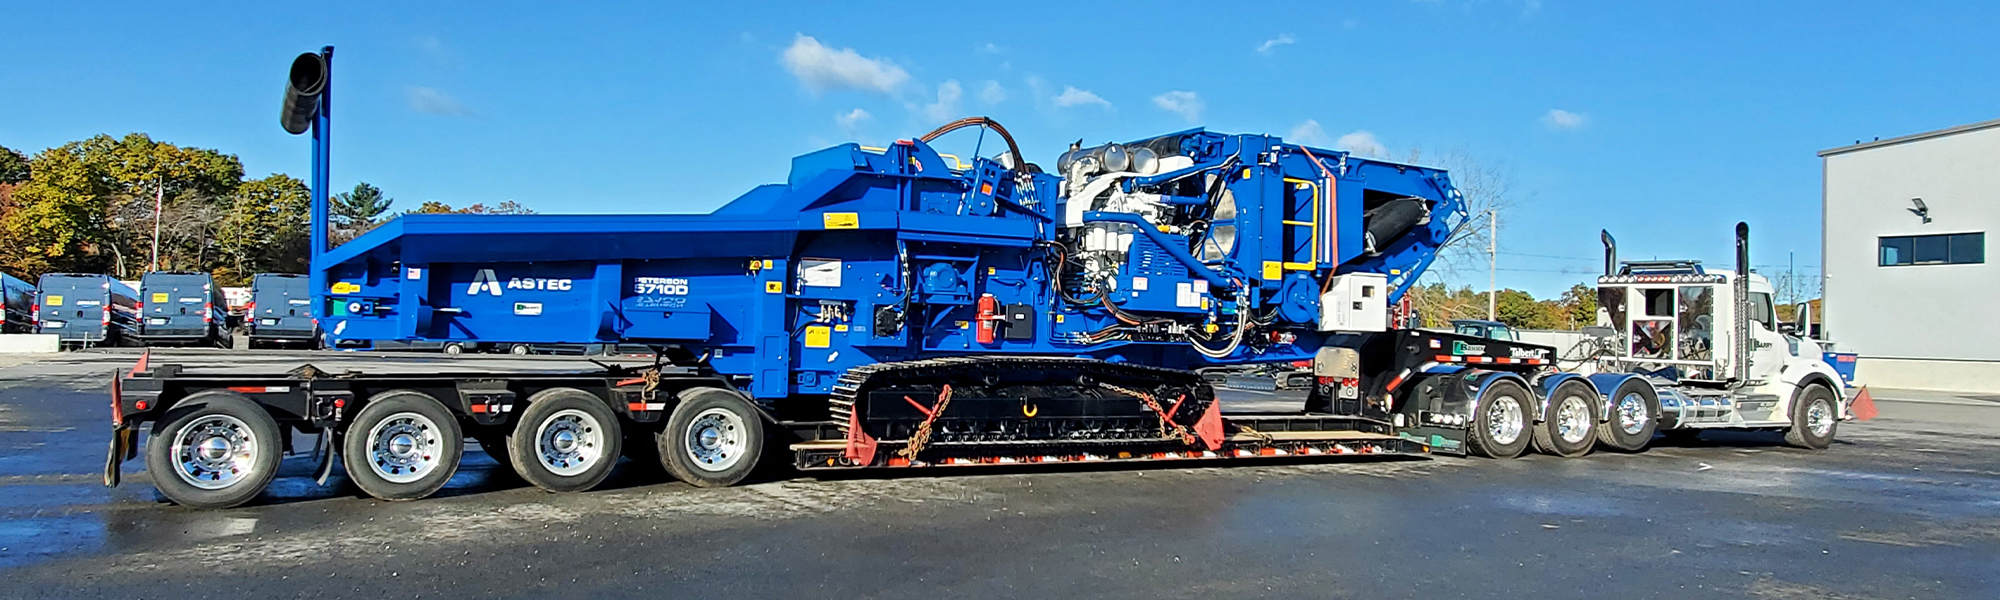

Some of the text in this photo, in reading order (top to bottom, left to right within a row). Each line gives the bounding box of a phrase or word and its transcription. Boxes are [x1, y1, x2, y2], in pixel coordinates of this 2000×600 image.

[507, 278, 571, 290] ASTEC
[635, 277, 688, 285] PETERSON
[634, 284, 688, 295] 5710D
